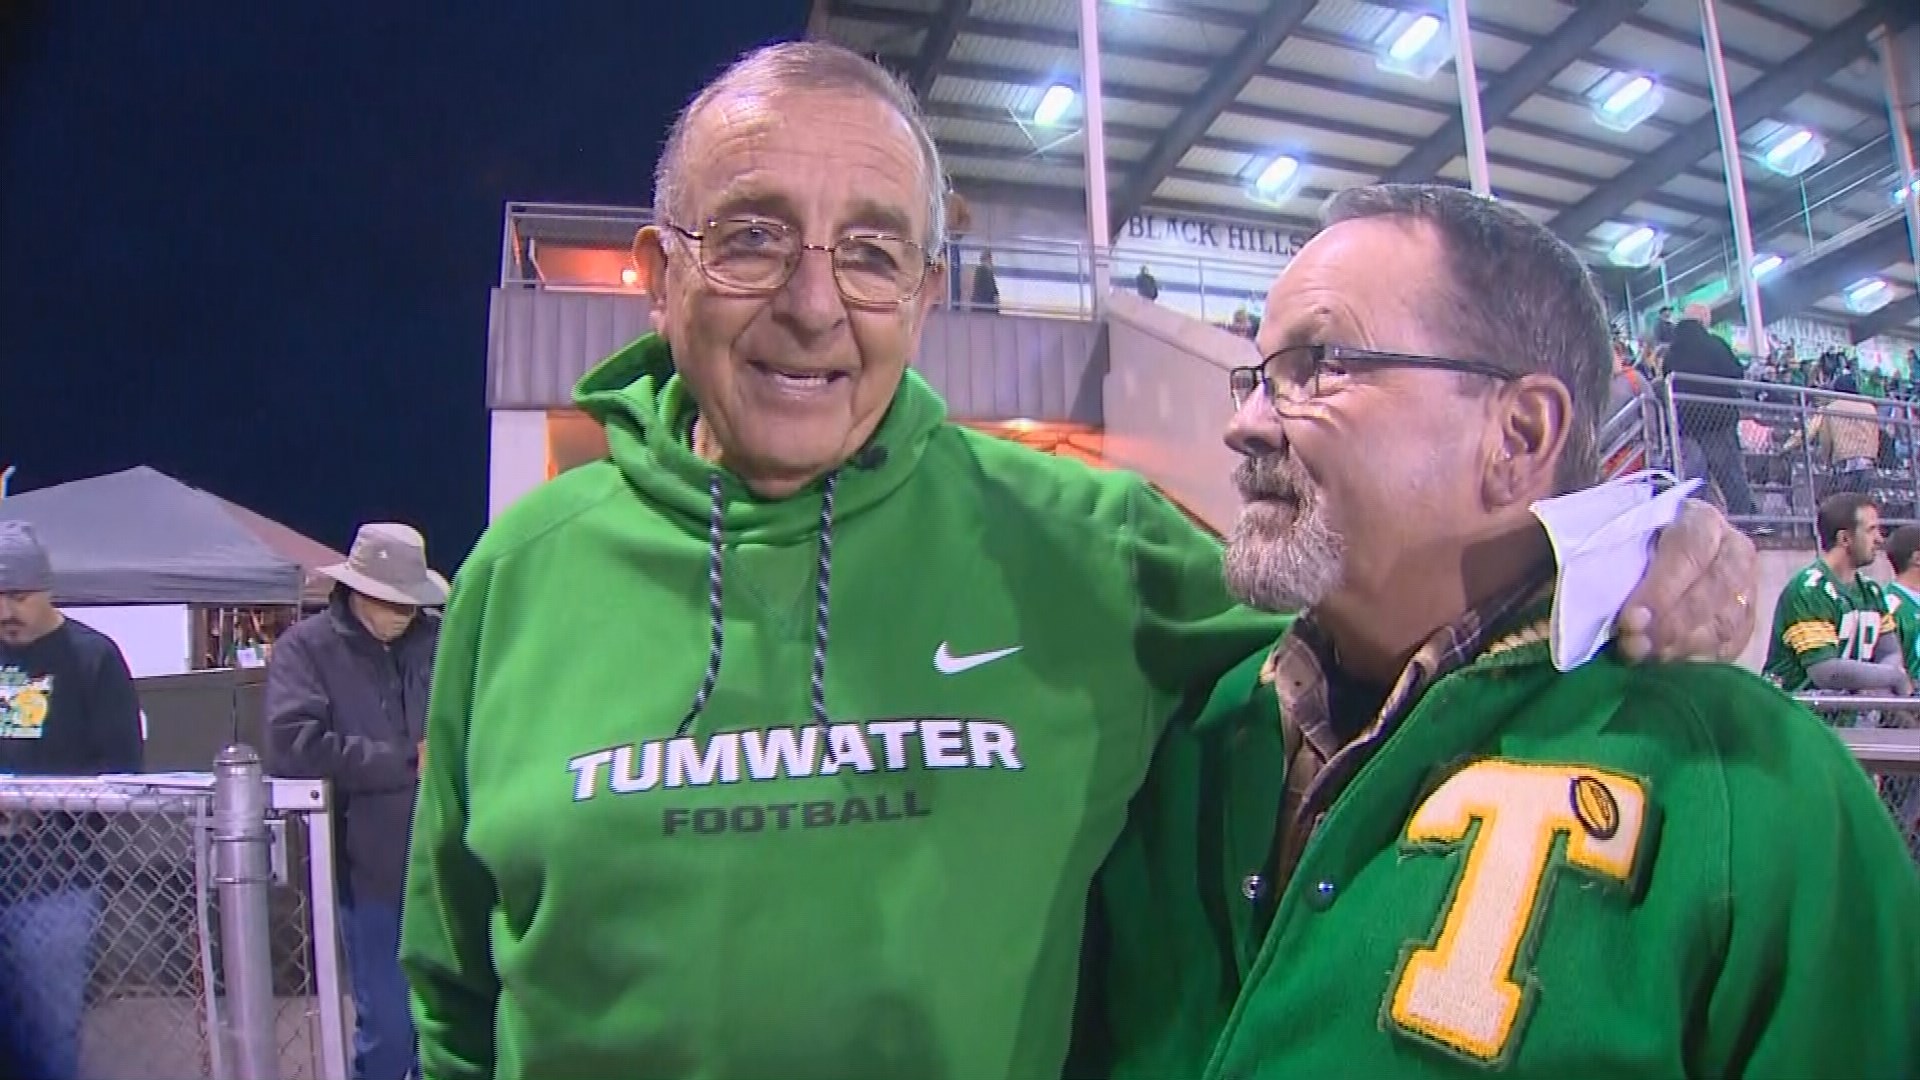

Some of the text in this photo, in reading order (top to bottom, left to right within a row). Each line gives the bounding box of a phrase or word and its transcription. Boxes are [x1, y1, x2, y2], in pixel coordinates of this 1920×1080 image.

[1128, 214, 1304, 257] BLACK HILLS
[568, 718, 1025, 802] TUMWATER
[662, 789, 932, 837] FOOTBALL
[1391, 757, 1646, 1063] T
